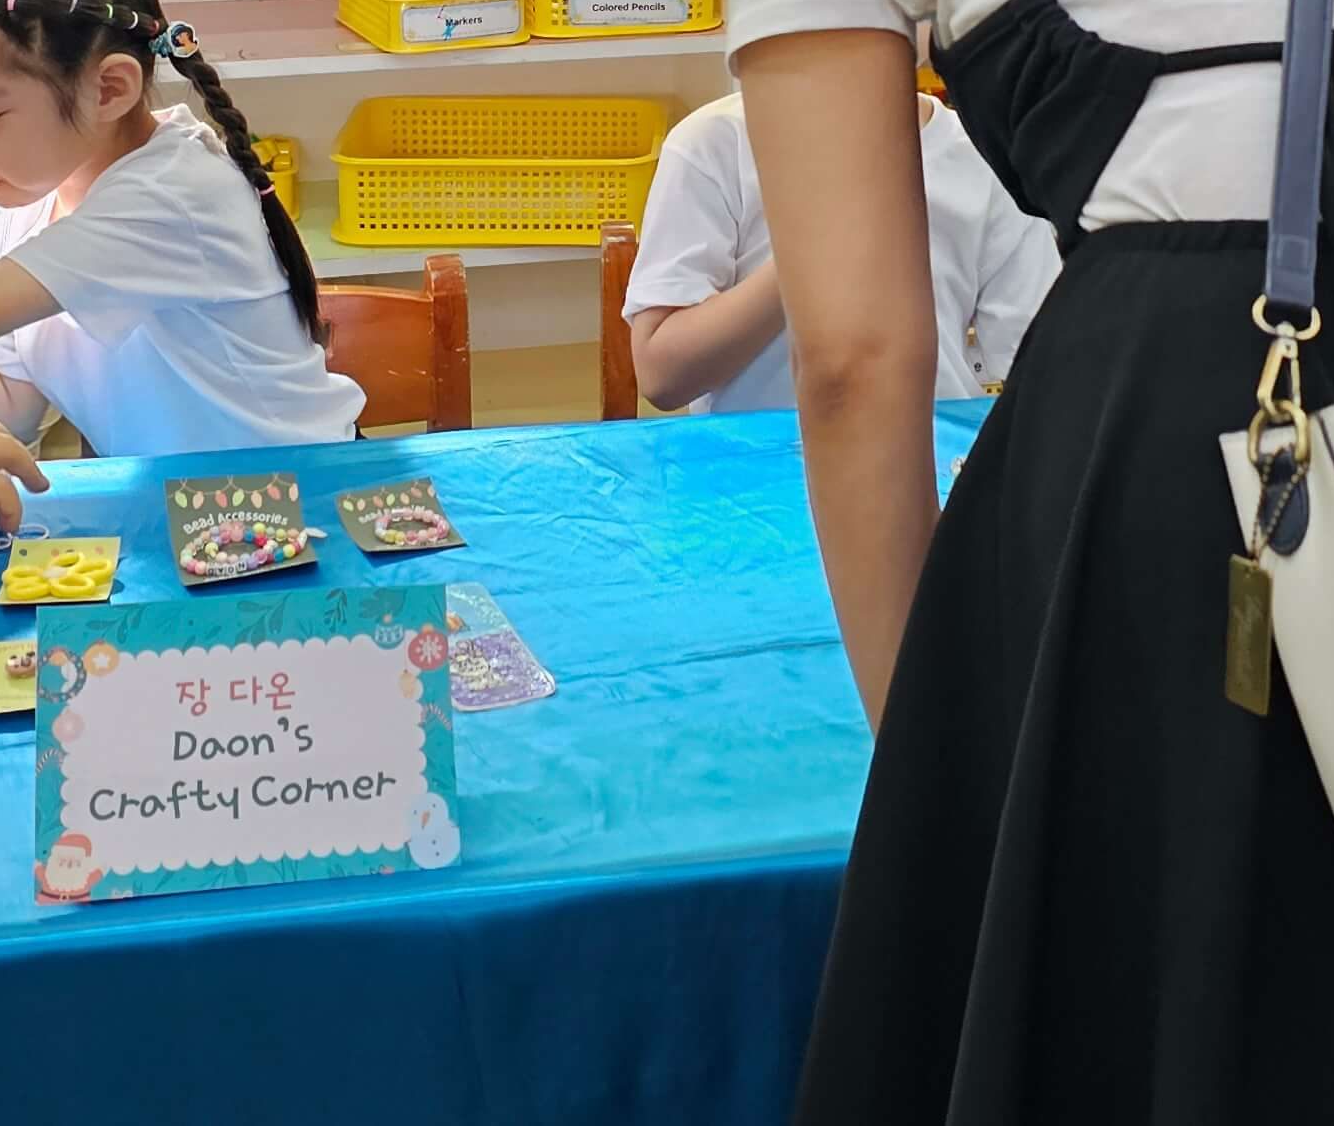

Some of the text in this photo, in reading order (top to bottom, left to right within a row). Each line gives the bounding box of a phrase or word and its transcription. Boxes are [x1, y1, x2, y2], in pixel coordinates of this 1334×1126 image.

[445, 14, 483, 27] Markers
[592, 1, 666, 13] Colored Pencils
[183, 511, 289, 534] Bead Accessories
[175, 672, 296, 717] 장 다온
[173, 717, 314, 761] Daon's
[89, 772, 397, 822] Crafty Corner
